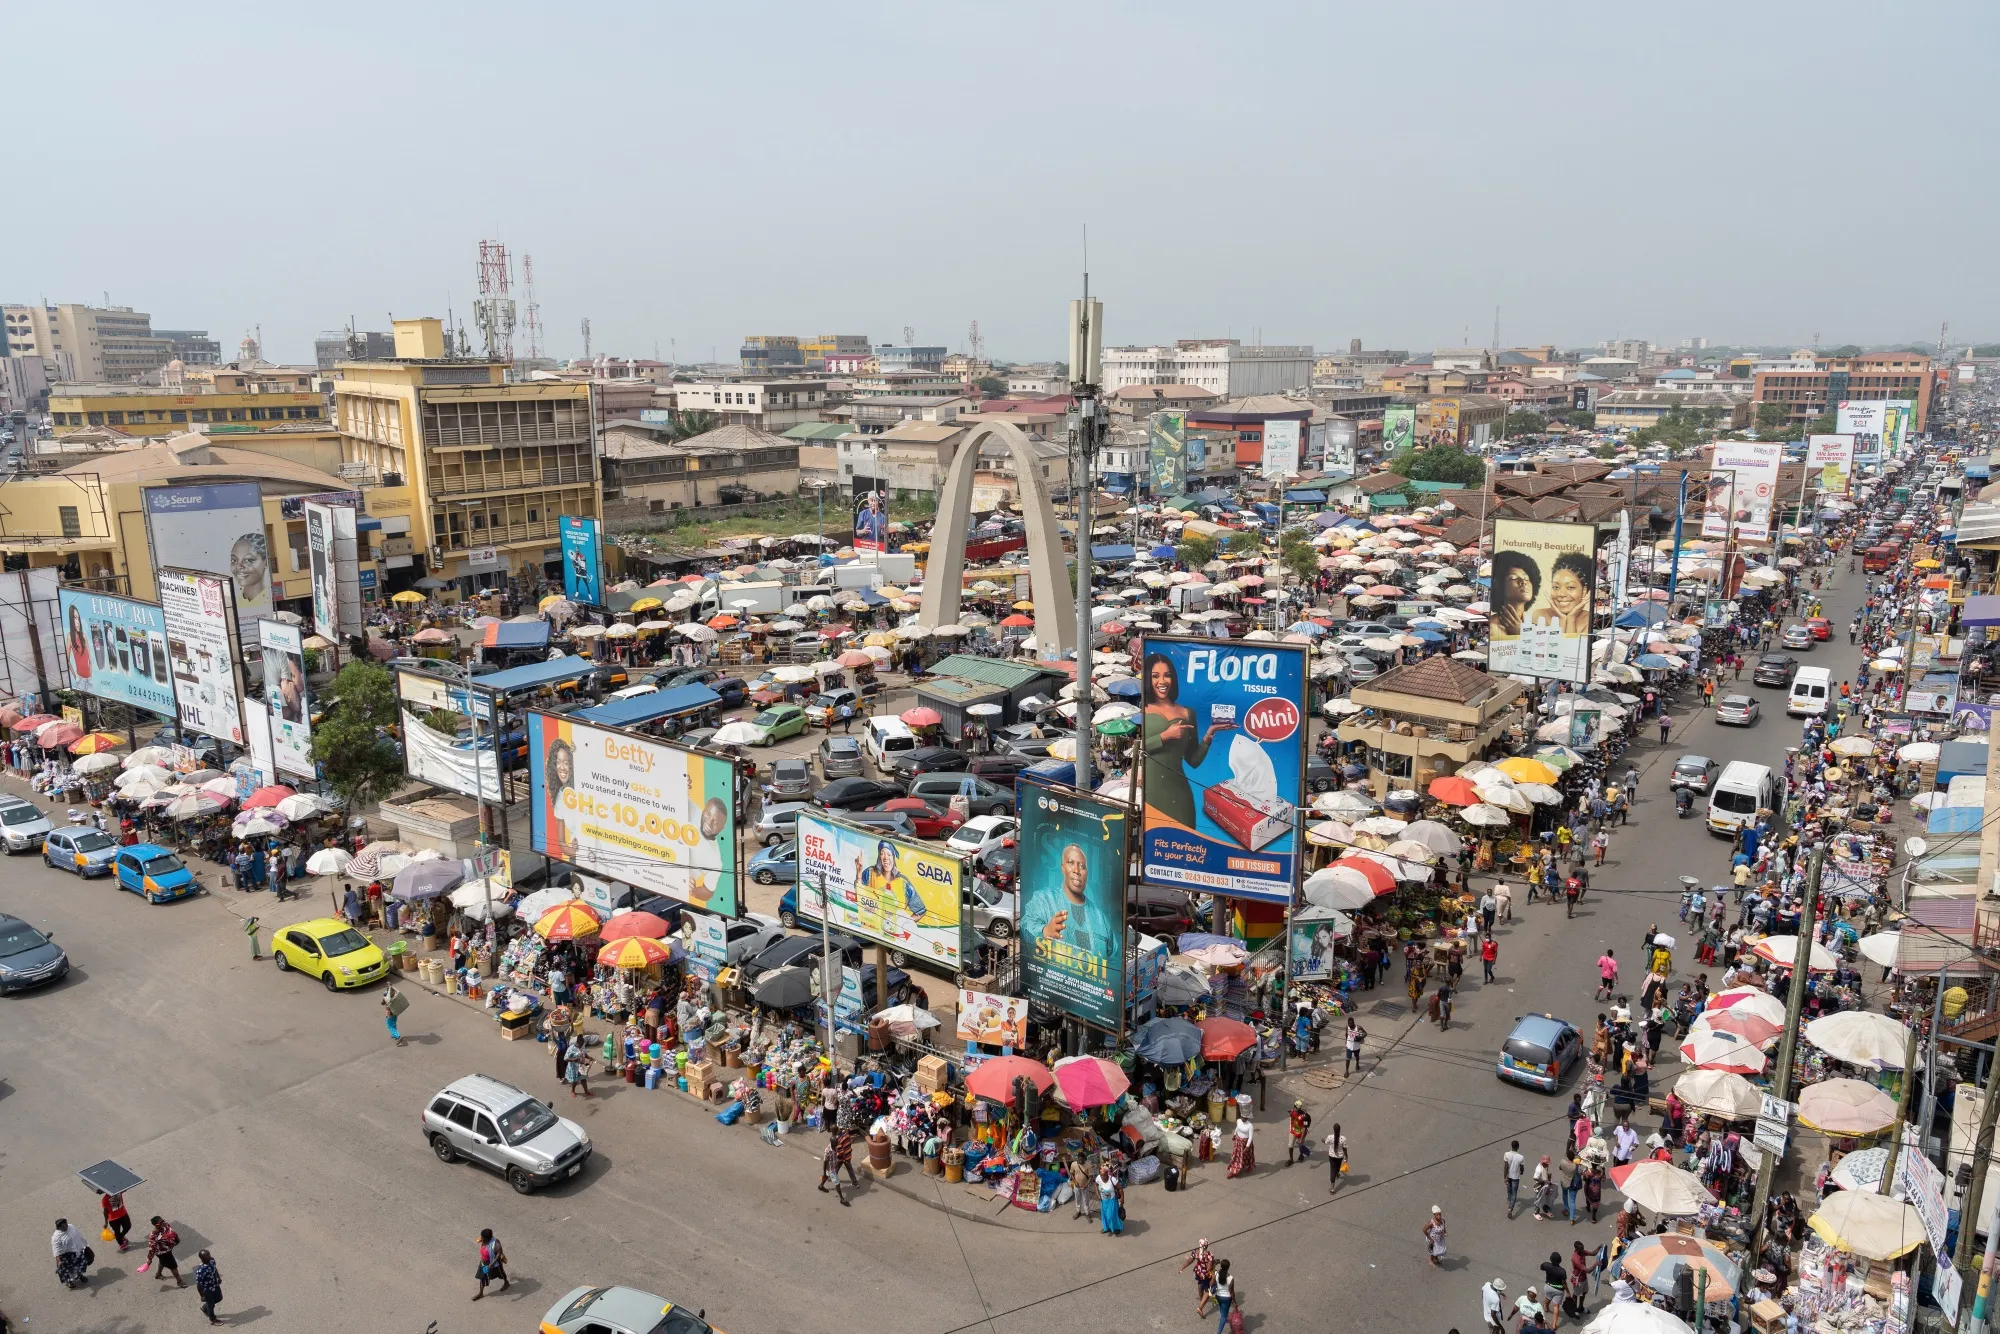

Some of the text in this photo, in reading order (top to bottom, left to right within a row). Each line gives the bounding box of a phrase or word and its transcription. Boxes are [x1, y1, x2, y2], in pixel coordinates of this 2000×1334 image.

[171, 495, 202, 505] Secure
[310, 524, 323, 537] GOOD
[312, 542, 324, 552] GOOD
[1502, 539, 1584, 552] Naturally Beautiful
[158, 569, 185, 581] SEWING
[160, 582, 198, 597] MACHINES!
[1492, 644, 1518, 652] NATURAL
[1186, 650, 1278, 684] Flora
[128, 685, 175, 708] 0244257969
[1243, 684, 1277, 694] TISSUES
[1251, 707, 1295, 730] Mini
[604, 737, 655, 772] Betty
[629, 764, 645, 772] BINGO
[591, 771, 661, 798] With only GHc 5
[581, 782, 594, 791] you
[596, 784, 616, 796] stand
[623, 791, 651, 806] chance
[652, 799, 660, 808] to
[662, 802, 676, 813] win
[562, 787, 700, 847] GHc 10,000
[1268, 807, 1288, 828] Flora
[586, 826, 670, 858] www.bettybingo.com.gh
[805, 834, 825, 848] GET
[1154, 839, 1207, 856] Fits Perfectly
[804, 846, 836, 866] SABA,
[1154, 848, 1205, 864] in your BAG
[805, 858, 842, 876] CLEAN THE
[917, 862, 953, 886] SABA
[1232, 860, 1275, 872] 100 TISSUES
[829, 874, 845, 886] WAY.
[1150, 868, 1229, 886] CONTACT US: 0243 033 033
[861, 896, 879, 910] SABA
[1035, 936, 1108, 980] SHILOH
[1045, 973, 1064, 983] SUNDAY
[1077, 984, 1102, 997] FEBRUARY
[1048, 968, 1066, 979] MONDAY
[1068, 975, 1080, 984] 20TH
[1080, 979, 1106, 992] FEBRUARY
